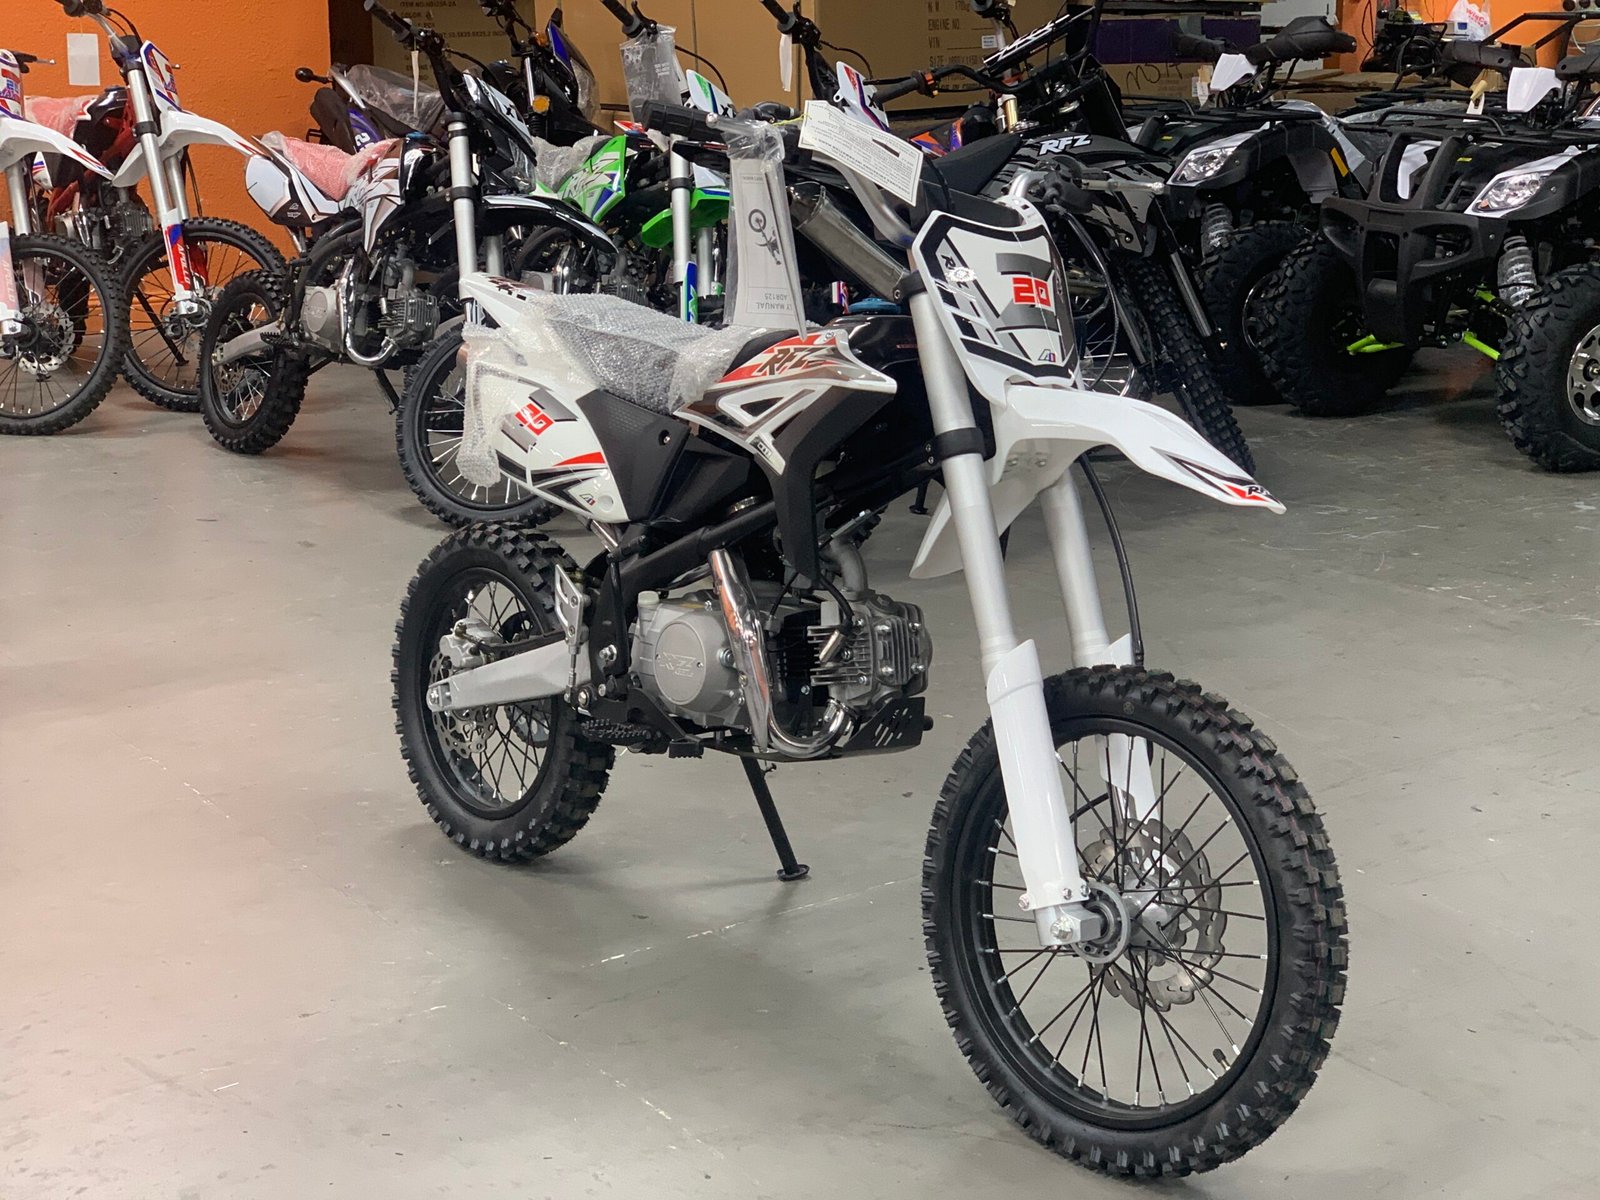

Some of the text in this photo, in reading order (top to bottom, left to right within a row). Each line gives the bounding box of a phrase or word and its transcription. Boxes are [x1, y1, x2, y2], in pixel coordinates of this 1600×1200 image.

[1039, 134, 1091, 155] RFZ
[177, 243, 190, 286] APOLLO
[941, 254, 969, 289] RZ
[756, 302, 784, 310] MANUAL
[1013, 277, 1051, 307] 20
